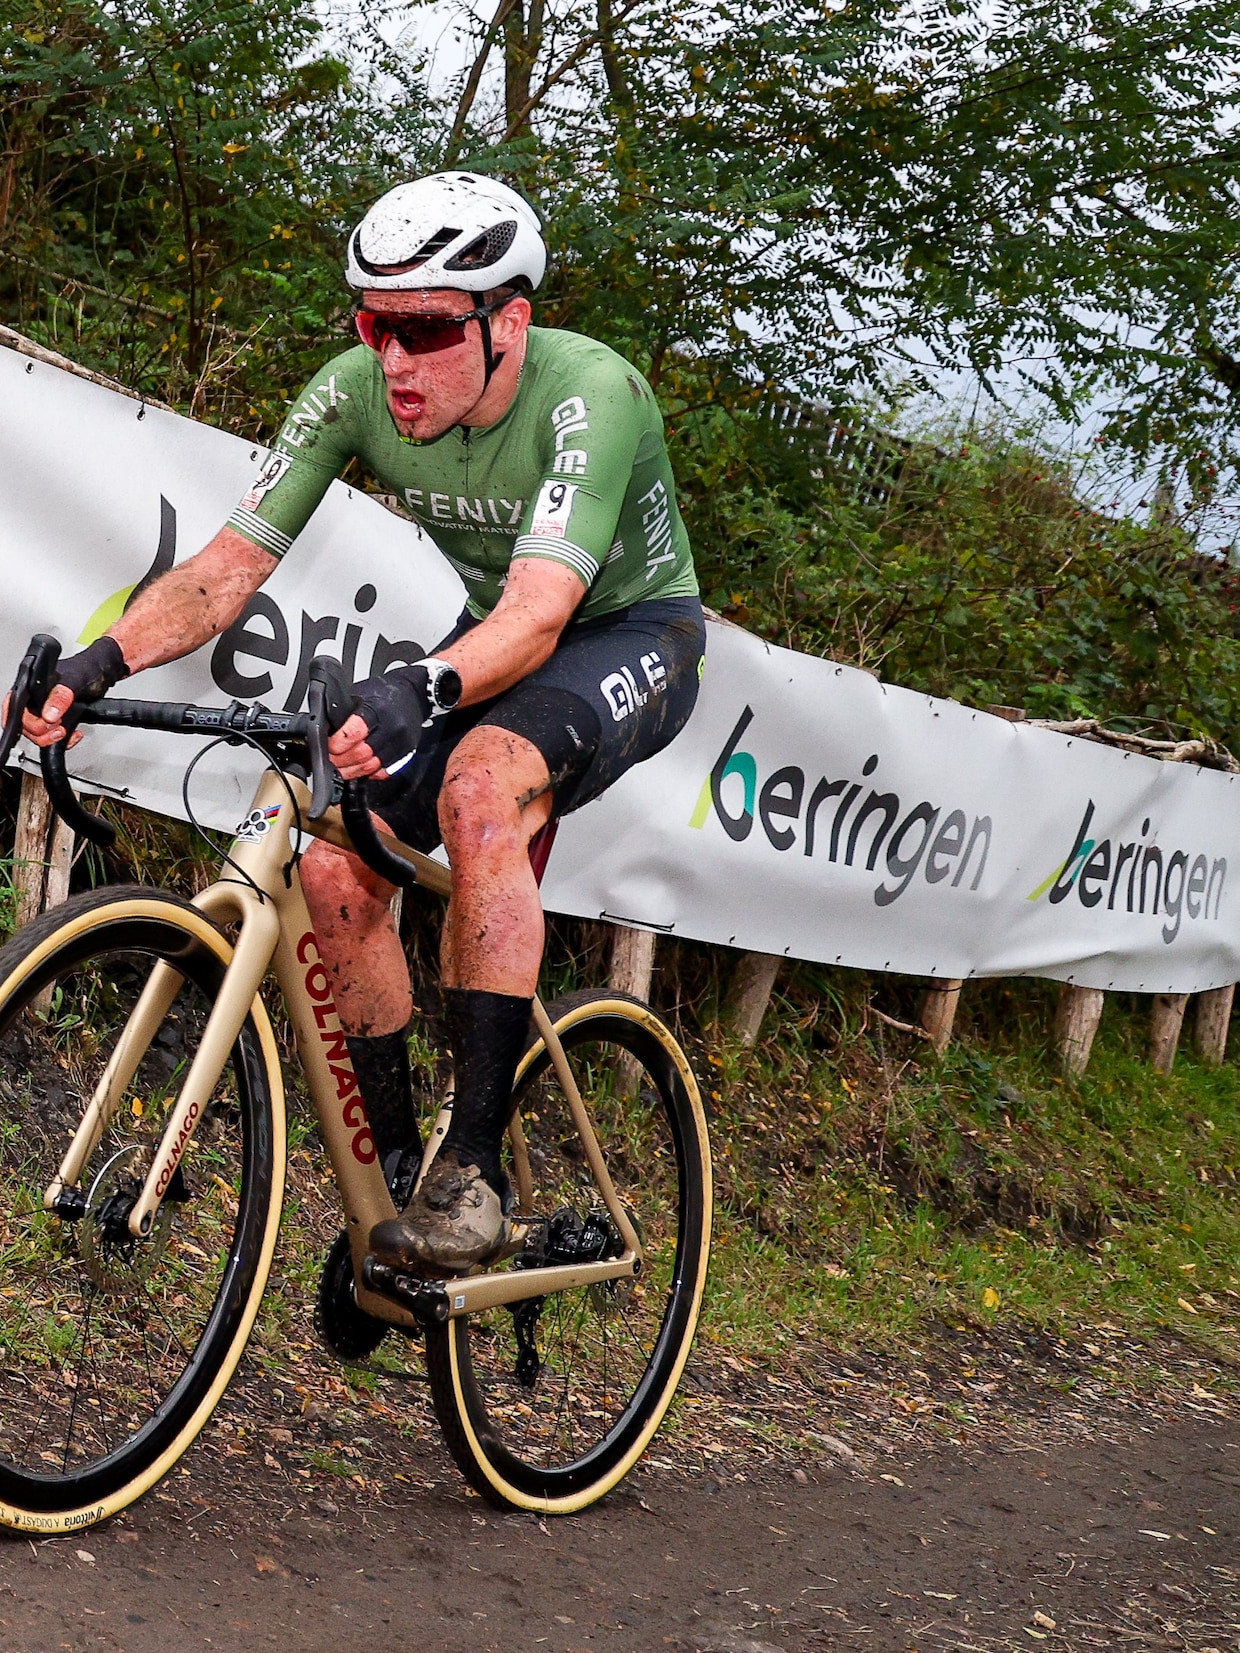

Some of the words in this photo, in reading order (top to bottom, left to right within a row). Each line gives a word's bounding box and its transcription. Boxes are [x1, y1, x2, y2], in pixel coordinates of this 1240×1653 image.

[273, 374, 349, 461] FENIX
[404, 487, 525, 525] FENIX
[548, 484, 567, 514] 9
[637, 479, 677, 582] FENIX
[689, 704, 992, 907] beringen
[1027, 799, 1227, 944] beringen
[296, 930, 379, 1166] COLNAGO
[154, 1101, 200, 1198] COLNAGO
[62, 1508, 99, 1530] vittoria
